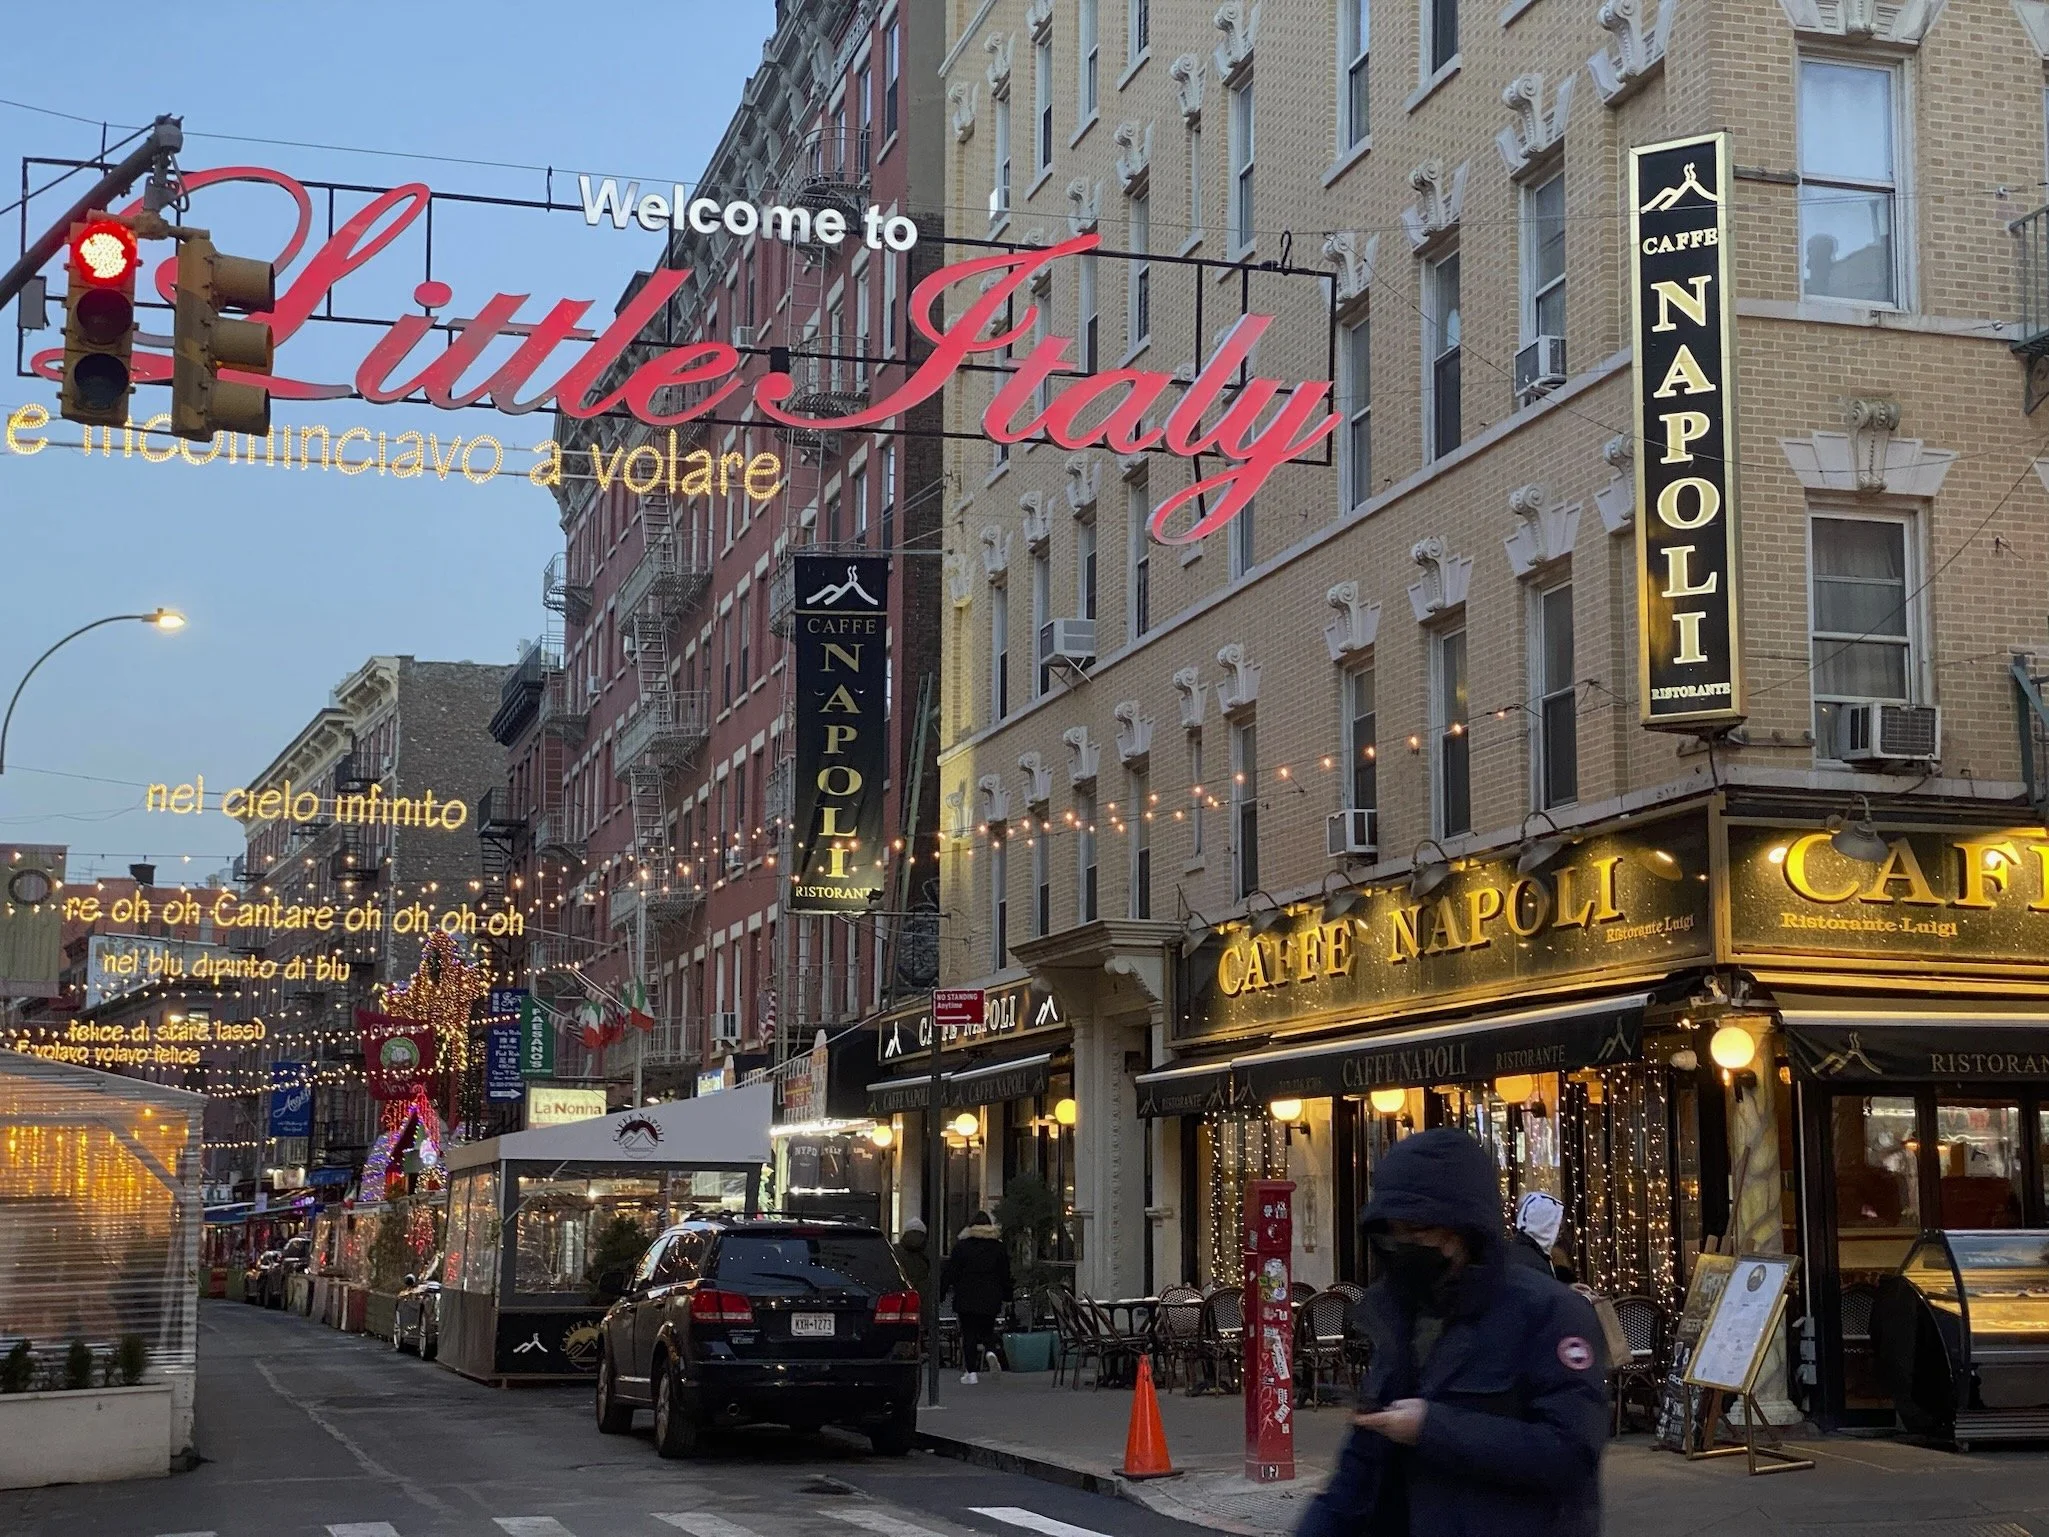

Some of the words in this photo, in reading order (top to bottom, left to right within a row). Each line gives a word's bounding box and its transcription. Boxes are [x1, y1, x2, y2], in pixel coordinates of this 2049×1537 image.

[578, 175, 847, 244] Welcome
[862, 204, 918, 252] to
[1642, 227, 1719, 256] CAFFE
[30, 166, 744, 427] Little
[751, 233, 1344, 546] Italy
[7, 402, 50, 455] e
[529, 438, 562, 487] a
[591, 429, 782, 500] volare
[1650, 274, 1721, 665] NAPOLI
[807, 617, 877, 635] CAFFE
[1650, 682, 1732, 701] RISTORANTE
[817, 642, 865, 879] NAPOLI
[146, 774, 205, 815] nel
[221, 779, 320, 822] cielo
[336, 783, 468, 831] infinito
[795, 885, 881, 900] RISTORANT
[111, 889, 150, 924] oh
[162, 892, 201, 926] oh
[214, 892, 335, 930] Cantare
[344, 900, 383, 933] oh
[393, 901, 430, 934] oh
[440, 902, 477, 935] oh
[487, 904, 525, 937] oh
[1217, 918, 1356, 997] CAFFE
[1387, 856, 1626, 964] NAPOLI
[1605, 920, 1664, 944] Ristorante
[1664, 914, 1695, 932] Luigi
[1780, 912, 1898, 933] Ristorante
[1900, 917, 1959, 937] Luigi
[103, 949, 139, 975] nel
[148, 949, 184, 976] blu
[191, 951, 278, 985] dipinto
[283, 953, 306, 980] di
[315, 954, 351, 982] blu
[936, 993, 946, 1001] NO
[947, 993, 978, 1001] STANDING
[936, 1001, 963, 1009] Anytime
[529, 1007, 544, 1069] PAESANO'S
[1342, 1052, 1394, 1088] CAFFE
[1399, 1043, 1467, 1084] NAPOLI
[1495, 1044, 1566, 1071] RISTORANTE
[534, 1102, 551, 1115] La
[553, 1102, 602, 1115] Nonna
